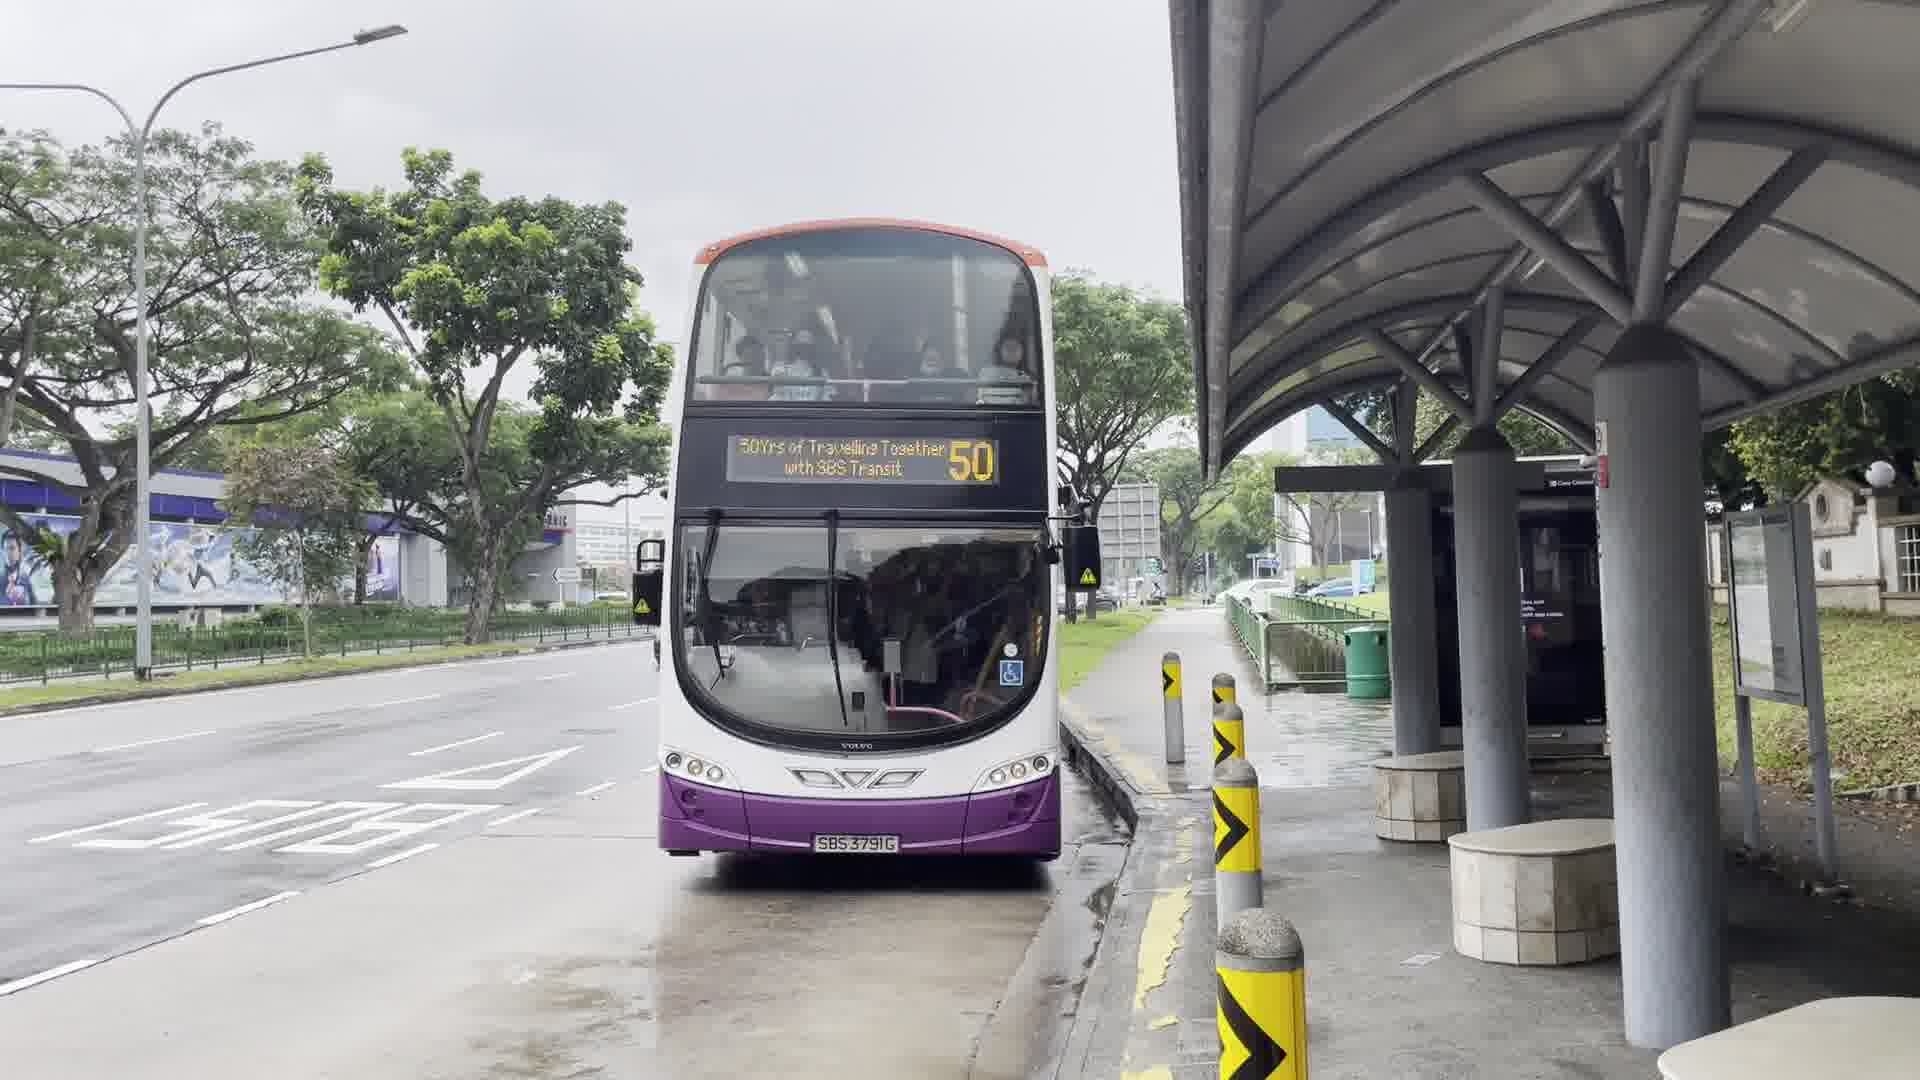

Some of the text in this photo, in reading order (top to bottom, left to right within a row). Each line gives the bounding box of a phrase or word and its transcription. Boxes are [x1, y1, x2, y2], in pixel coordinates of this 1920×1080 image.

[788, 439, 803, 458] of
[808, 440, 878, 460] Travelling
[881, 441, 945, 461] Together
[949, 441, 994, 481] 50
[784, 460, 905, 479] with SBS Transit
